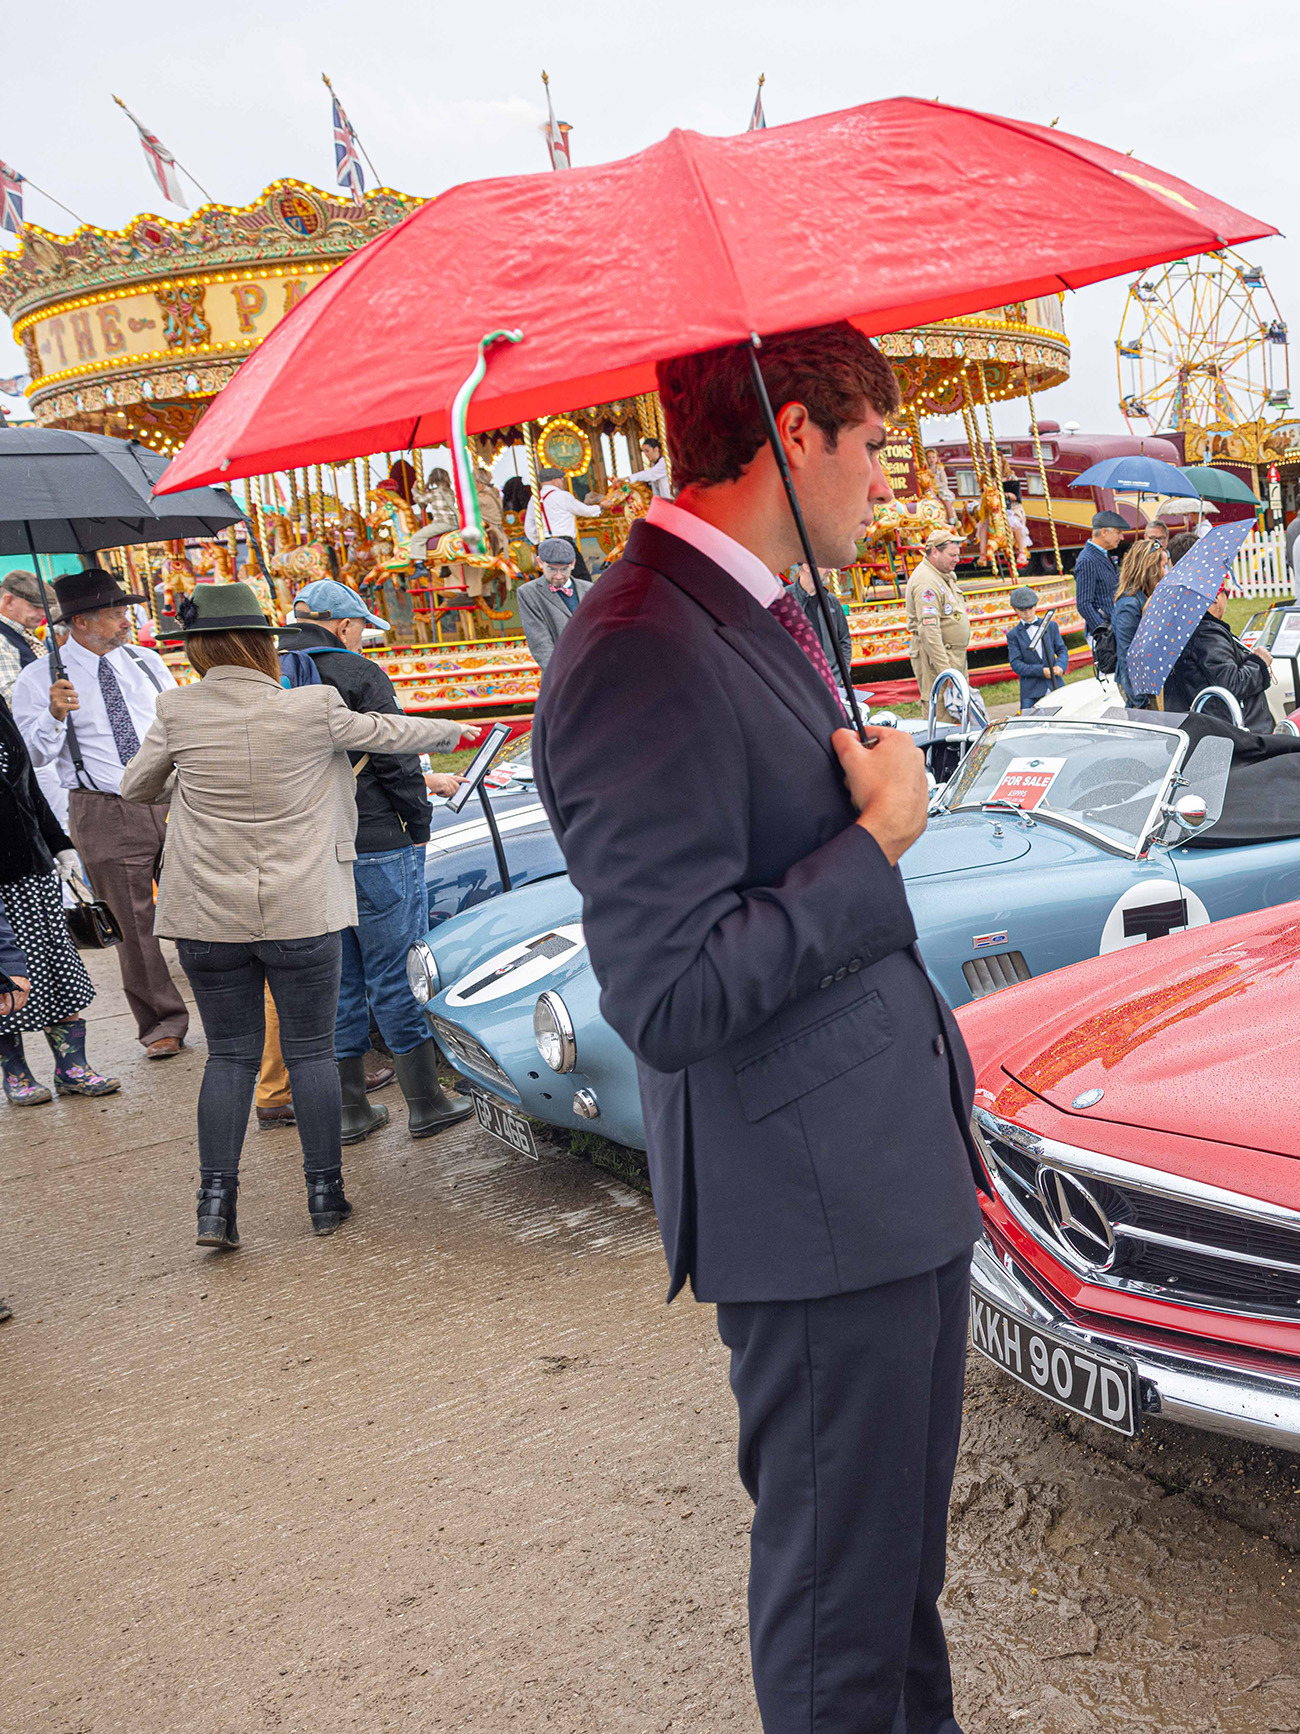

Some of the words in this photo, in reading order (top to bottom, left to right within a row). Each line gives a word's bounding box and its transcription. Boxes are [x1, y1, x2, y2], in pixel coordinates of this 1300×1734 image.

[46, 304, 128, 366] THE
[1001, 775, 1023, 786] FOR
[1022, 776, 1052, 787] SALE
[502, 1113, 530, 1153] 466
[971, 1295, 1022, 1373] KKH
[1029, 1336, 1126, 1422] 907D
